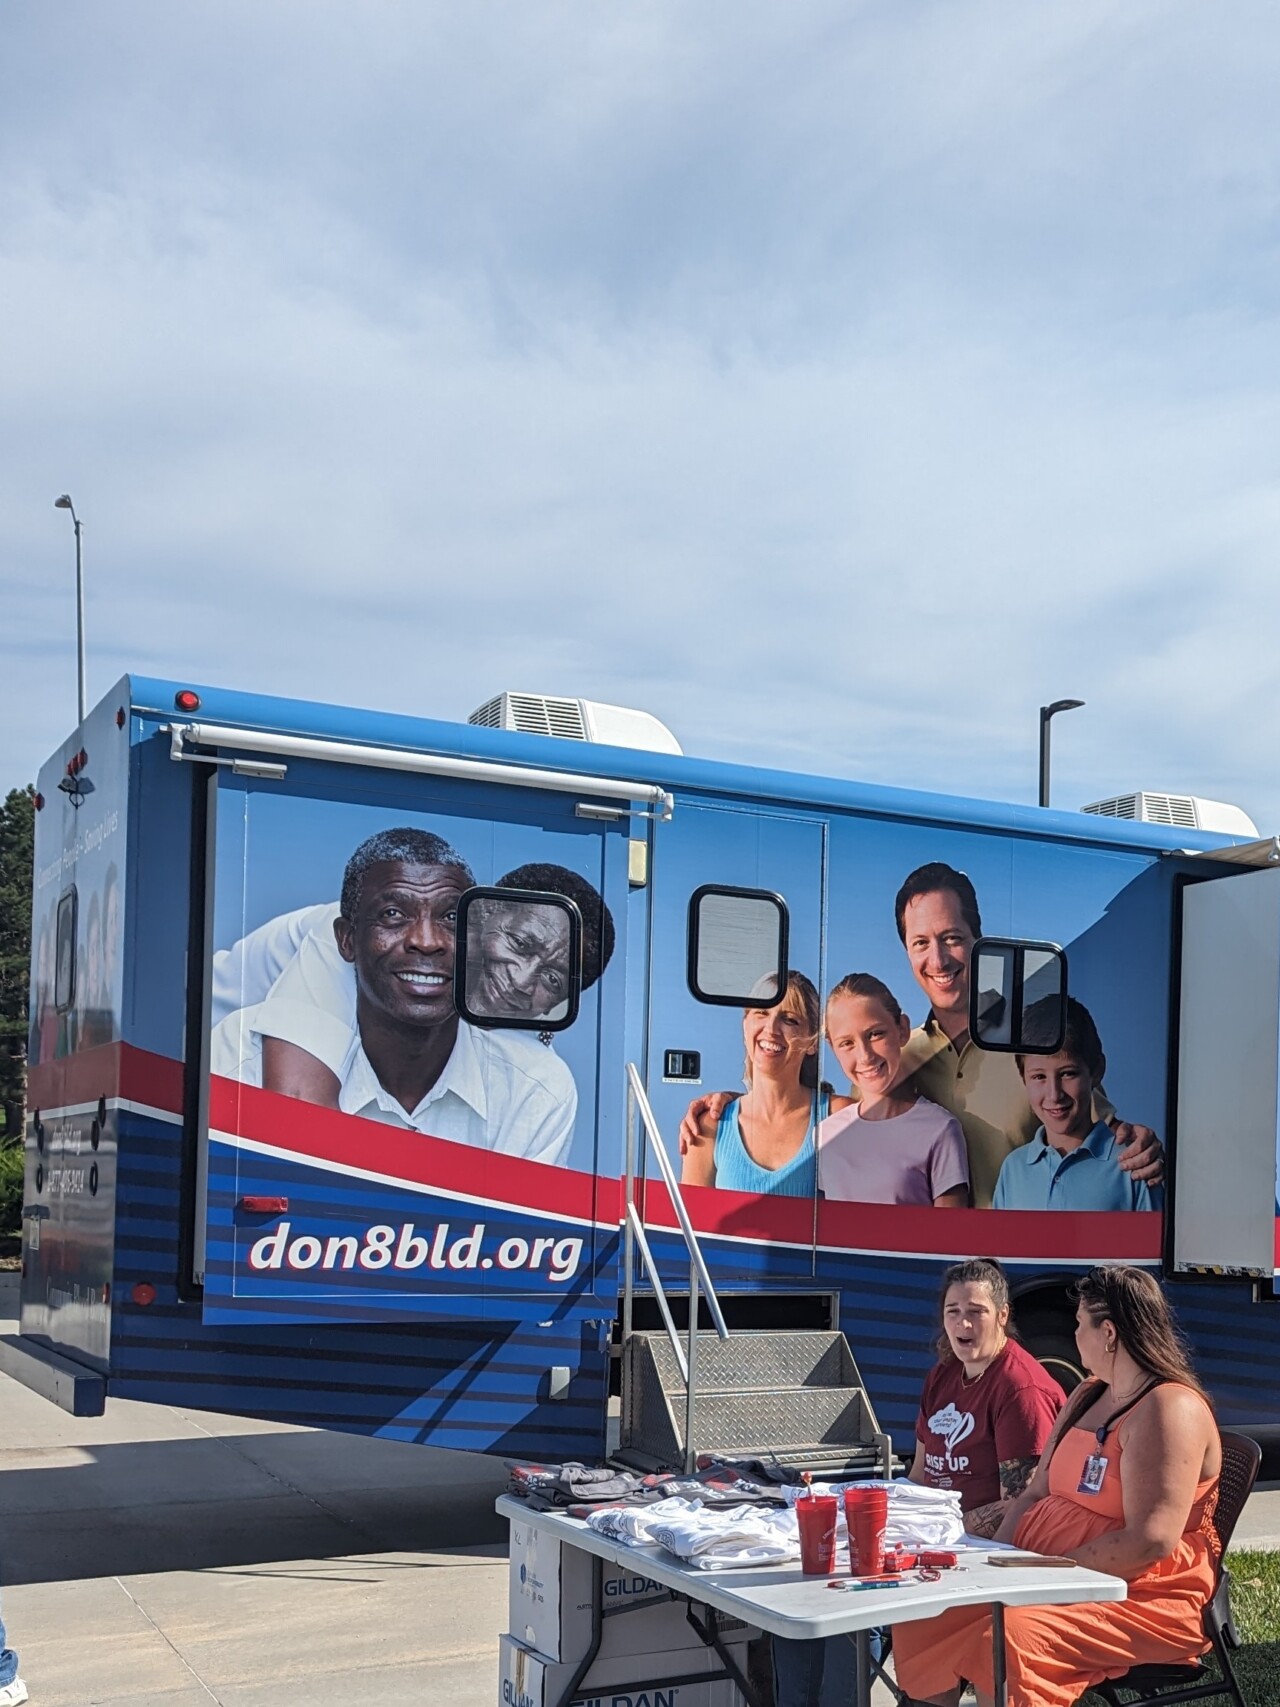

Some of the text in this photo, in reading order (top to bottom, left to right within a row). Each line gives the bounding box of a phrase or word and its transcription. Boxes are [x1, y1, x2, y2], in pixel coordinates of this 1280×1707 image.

[250, 1222, 584, 1282] don8bld.org
[925, 1453, 969, 1471] RISE UP
[604, 1577, 663, 1597] GILDA
